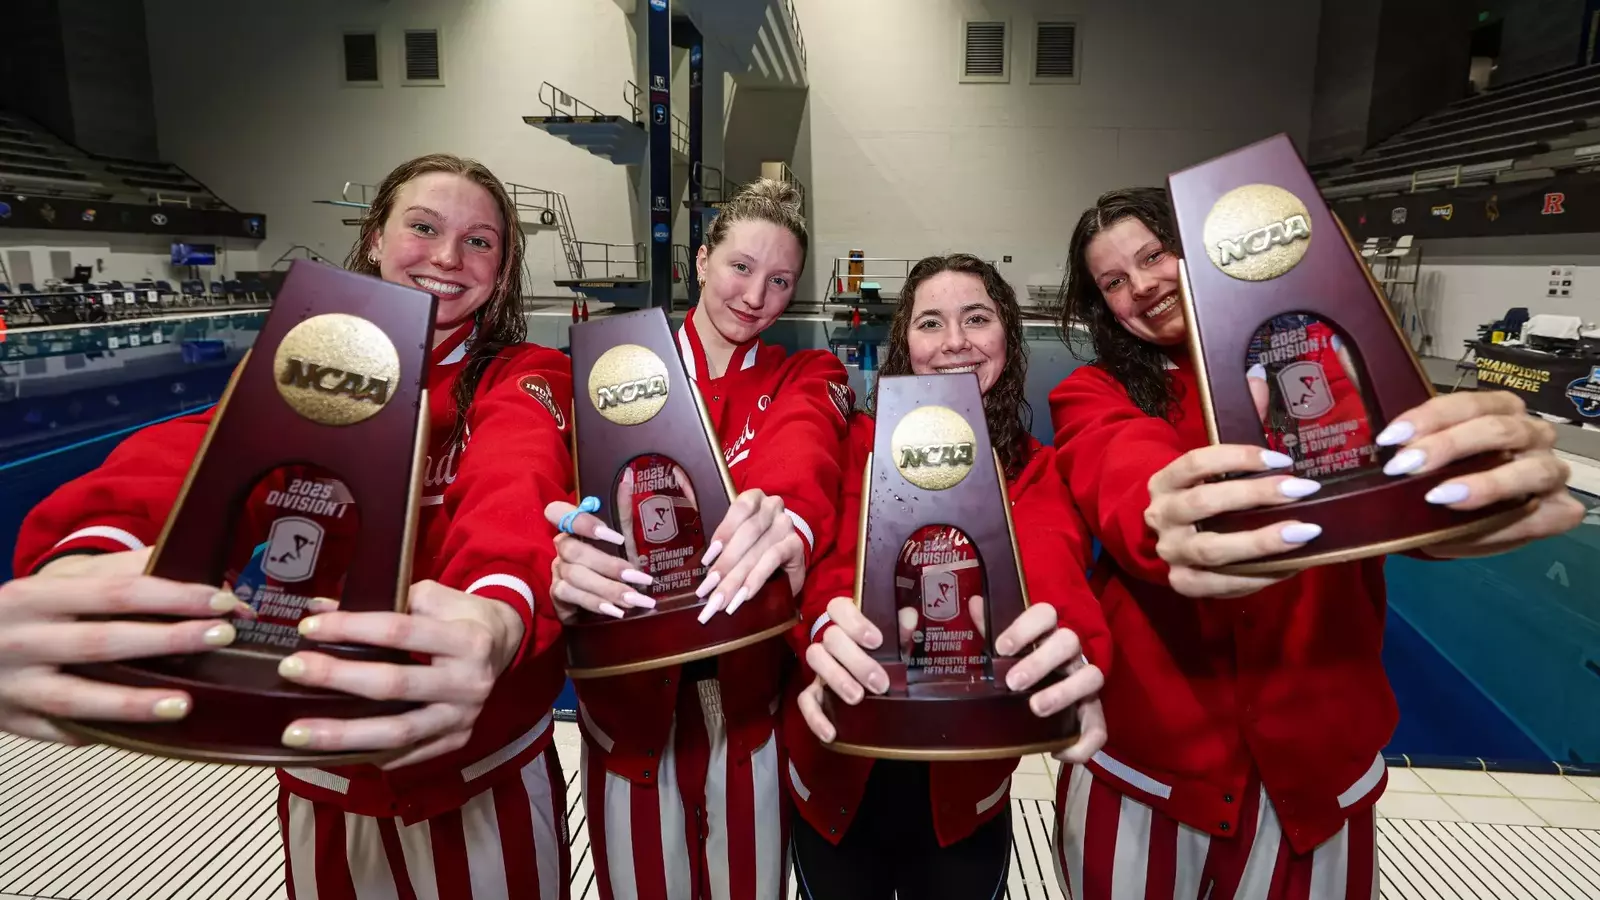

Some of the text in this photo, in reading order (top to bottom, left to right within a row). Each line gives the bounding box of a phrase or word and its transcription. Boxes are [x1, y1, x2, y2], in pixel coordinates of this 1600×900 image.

[1217, 214, 1310, 266] NCAA
[1270, 328, 1307, 349] 2025
[1259, 337, 1320, 366] DIVISION
[280, 355, 389, 405] NCAA
[1475, 357, 1551, 383] CHAMPIONS
[1478, 369, 1541, 393] WIN HERE
[597, 374, 668, 410] NCAA
[1299, 420, 1359, 443] SWIMMING
[1310, 433, 1347, 452] DIVING
[900, 442, 974, 468] NCAA
[1306, 457, 1360, 478] FIFTH PLACE
[288, 478, 333, 499] 2025
[634, 474, 673, 495] IVISION
[265, 490, 338, 517] DIVISION
[649, 546, 694, 564] SWIMMING
[657, 557, 684, 571] DIVING
[652, 583, 671, 594] FIFTH
[671, 578, 691, 589] PLACE
[661, 570, 691, 583] FREESTYLE
[259, 603, 303, 620] DIVING
[925, 630, 973, 641] SWIMMING
[932, 640, 962, 652] DIVING
[916, 656, 933, 665] YARD
[933, 655, 967, 665] FREESTYLE
[968, 655, 987, 664] RELAY
[924, 665, 966, 675] FIFTH PLACE
